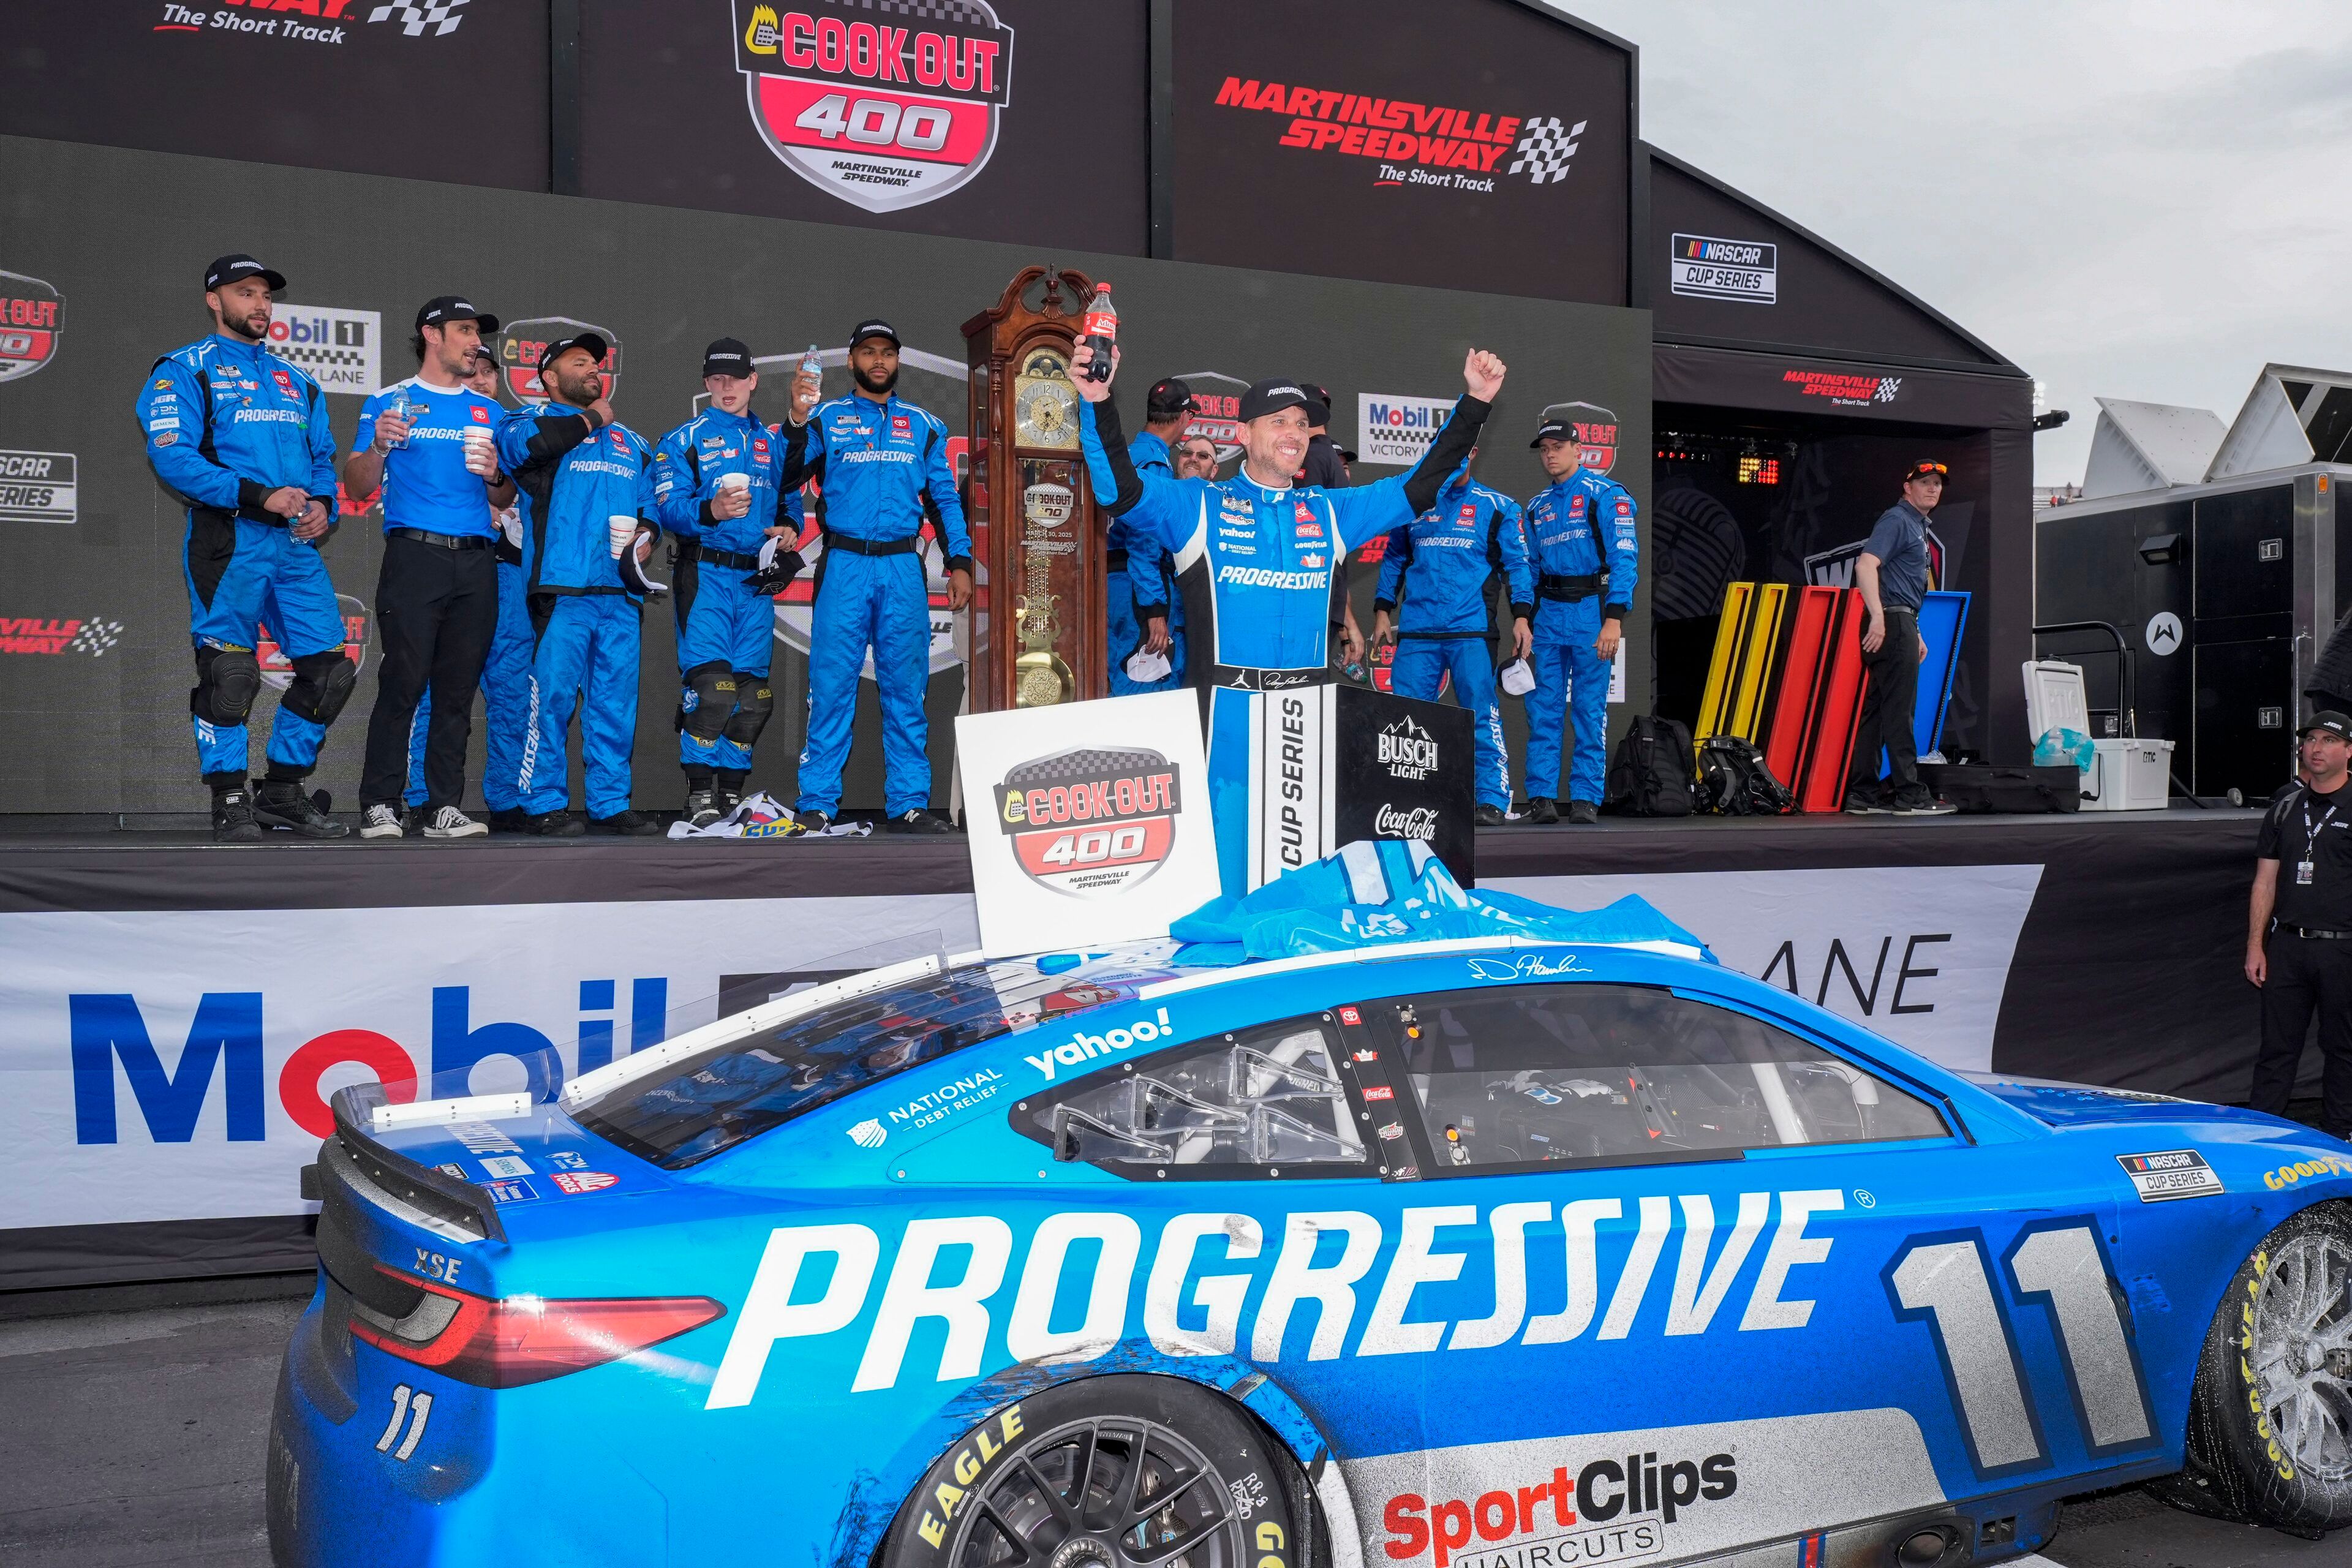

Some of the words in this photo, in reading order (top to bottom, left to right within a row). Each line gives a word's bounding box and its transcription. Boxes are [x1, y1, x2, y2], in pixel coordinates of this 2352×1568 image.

[162, 4, 206, 25] The
[209, 11, 277, 35] Short
[282, 20, 347, 44] Track
[782, 12, 909, 83] COOK
[915, 32, 999, 93] OUT
[1215, 77, 1521, 144] MARTINSVILLE
[795, 94, 952, 151] 400
[1279, 118, 1509, 173] SPEEDWAY
[831, 160, 922, 178] MARTINSVILLE
[1379, 165, 1406, 181] The
[1408, 168, 1451, 187] Short
[1455, 173, 1494, 192] Track
[842, 173, 910, 187] SPEEDWAY
[1705, 243, 1762, 265] NASCAR
[1686, 267, 1714, 284] CUP
[1715, 271, 1762, 289] SERIES
[11, 299, 58, 327] OUT
[426, 309, 441, 320] JGR
[268, 316, 329, 344] obil
[345, 322, 354, 345] 1
[861, 325, 893, 334] PROGRESSIVE
[520, 341, 548, 364] CO
[319, 368, 364, 385] LANE
[1783, 371, 1880, 388] MARTINSVILLE
[1033, 388, 1038, 396] 11
[1044, 385, 1050, 393] 12
[1802, 384, 1877, 399] SPEEDWAY
[151, 394, 176, 405] JGR
[1065, 399, 1069, 407] 2
[1370, 403, 1428, 428] Mobil
[1438, 410, 1444, 426] 1
[409, 428, 465, 441] PROGRE
[1184, 422, 1235, 440] 400
[1591, 424, 1616, 445] OUT
[842, 450, 916, 464] PROGRESSIVE
[1370, 444, 1419, 457] VICTORY
[570, 461, 635, 480] PROGRESSIVE
[1056, 495, 1071, 505] OUT
[1219, 527, 1255, 538] yahoo!
[1297, 526, 1319, 536] Coca-Cola
[1295, 541, 1327, 549] GOODYEAR
[1415, 537, 1475, 549] PROGRESSIVE
[1217, 565, 1327, 589] PROGRESSIVE
[519, 674, 540, 794] PROGRESSIVE
[2324, 721, 2343, 731] JGR
[1282, 697, 1303, 802] SERIES
[1377, 733, 1438, 771] BUSCH
[1489, 703, 1509, 794] PROGRESSIVE
[2143, 752, 2156, 763] RTIC
[1390, 764, 1425, 780] LIGHT
[1026, 781, 1114, 825] COOK
[1114, 774, 1172, 815] OUT
[2326, 805, 2337, 819] JGR
[1375, 804, 1439, 840] Coca-Cola
[2313, 823, 2323, 837] JGR
[1281, 805, 1302, 867] CUP
[1042, 827, 1145, 865] 400
[1069, 871, 1129, 883] MARTINSVILLE
[1076, 879, 1121, 889] SPEEDWAY
[1762, 933, 1952, 1016] ANE
[1023, 1007, 1173, 1081] yahoo!
[888, 1068, 1003, 1124] NATIONAL
[1365, 1088, 1391, 1099] Coca-Cola
[915, 1105, 954, 1129] DEBT
[954, 1085, 998, 1114] RELIEF
[493, 1159, 519, 1175] SIEMENS
[553, 1159, 568, 1170] SOLUTIONS
[564, 1158, 590, 1169] DN
[2148, 1154, 2193, 1169] NASCAR
[555, 1174, 581, 1193] TOOLS
[568, 1172, 615, 1191] MAC
[2146, 1175, 2167, 1189] CUP
[2169, 1171, 2206, 1187] SERIES
[414, 1247, 462, 1284] XSE
[705, 1189, 1845, 1410] PROGRESSIVE
[1887, 1219, 2157, 1475] 11
[2241, 1250, 2294, 1480] GOODYEAR
[375, 1384, 433, 1461] 11
[918, 1404, 1024, 1550] EAGLE
[1383, 1452, 1738, 1568] SportClips
